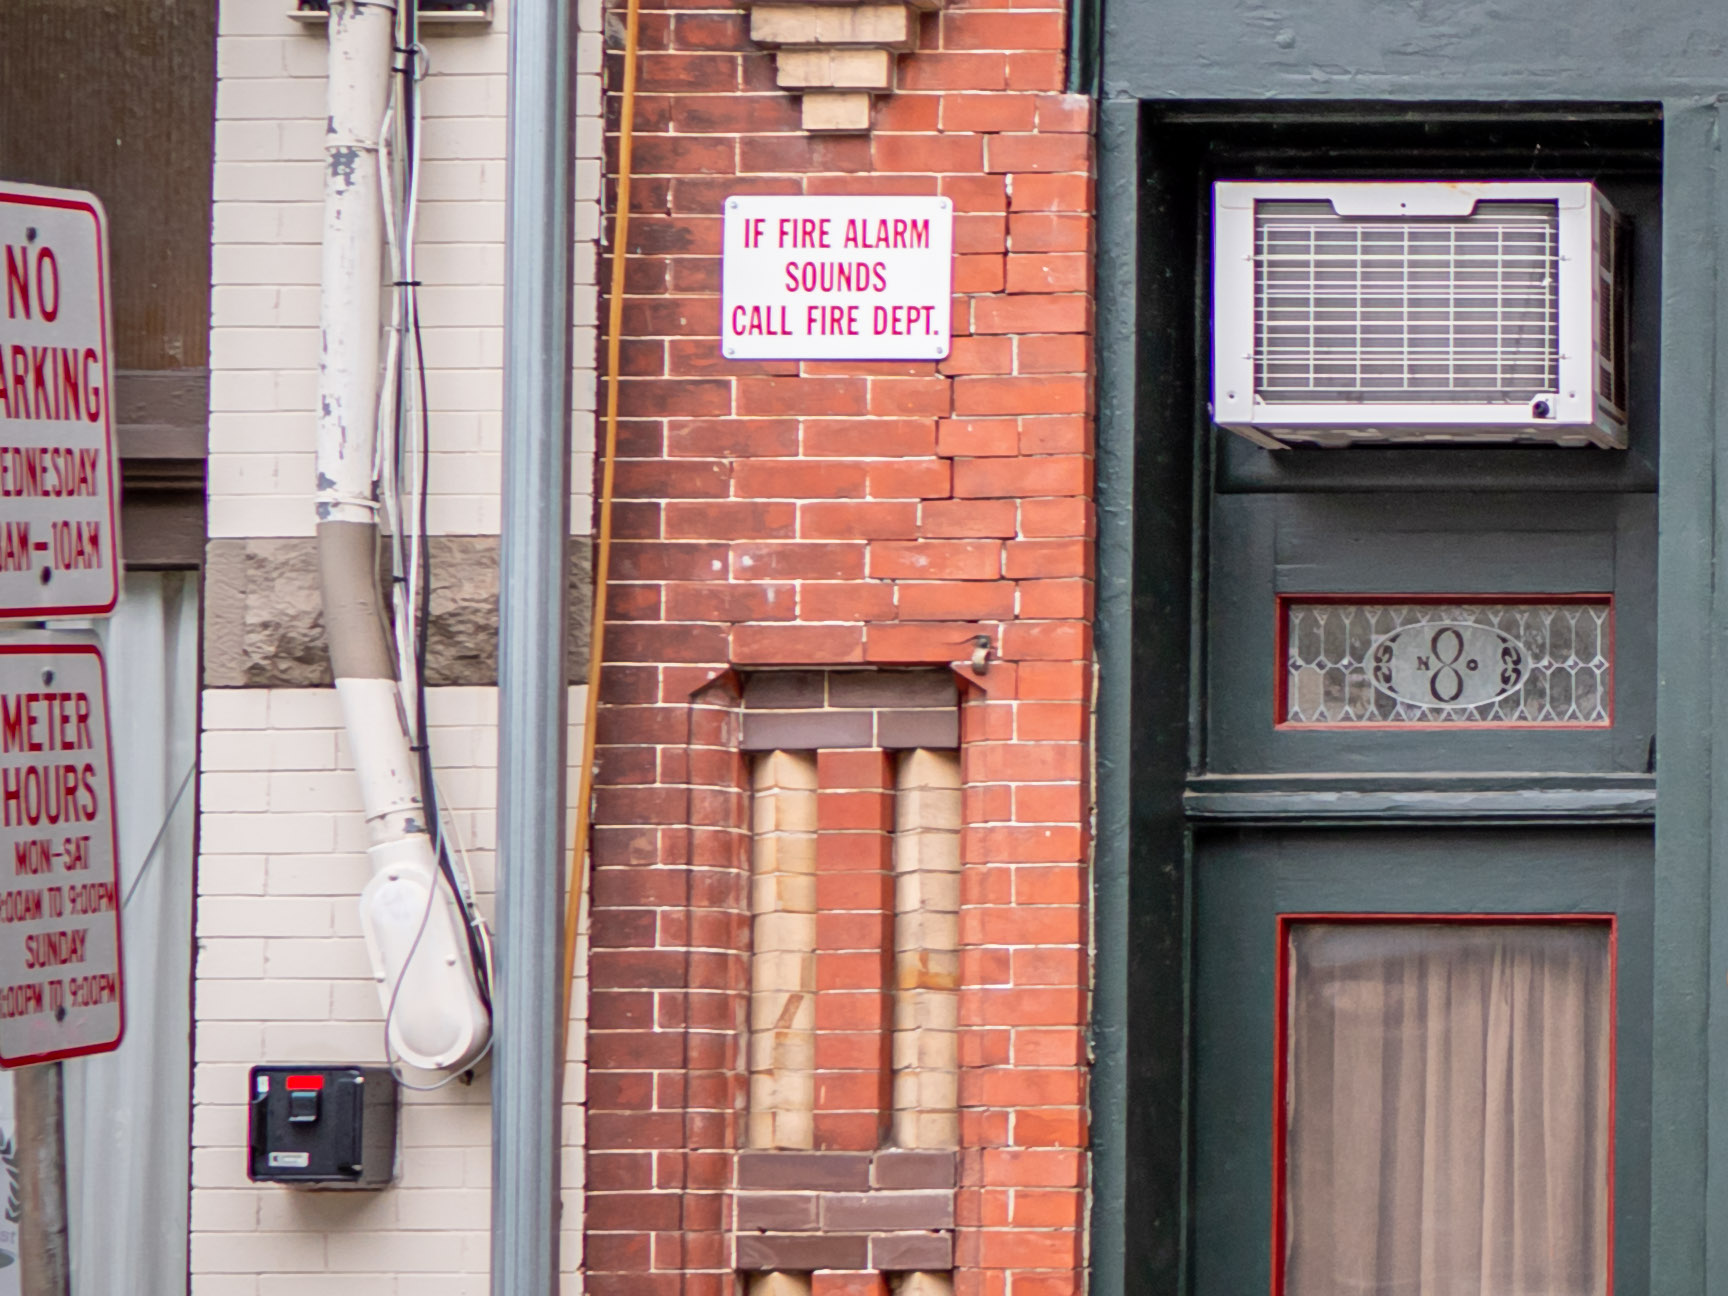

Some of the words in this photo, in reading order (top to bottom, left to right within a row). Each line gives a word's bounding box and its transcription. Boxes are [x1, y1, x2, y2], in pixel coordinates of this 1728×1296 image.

[744, 218, 766, 249] IF
[778, 218, 831, 249] FIRE
[844, 218, 930, 249] ALARM
[5, 244, 60, 323] NO
[785, 261, 887, 293] SOUNDS
[732, 304, 793, 337] CALL
[807, 305, 859, 336] FIRE
[873, 305, 939, 336] DEPT.
[0, 520, 103, 572] AM-10AM
[1, 692, 93, 753] METER
[2, 763, 98, 827] HOURS
[14, 835, 91, 876] MON-SAT
[0, 889, 43, 923] :00AM
[47, 886, 63, 918] TO
[69, 881, 117, 915] 9:00PM
[25, 928, 89, 969] SUNDAY
[0, 982, 44, 1018] :00PM
[48, 979, 64, 1011] TO
[69, 972, 118, 1008] 9:00PM
